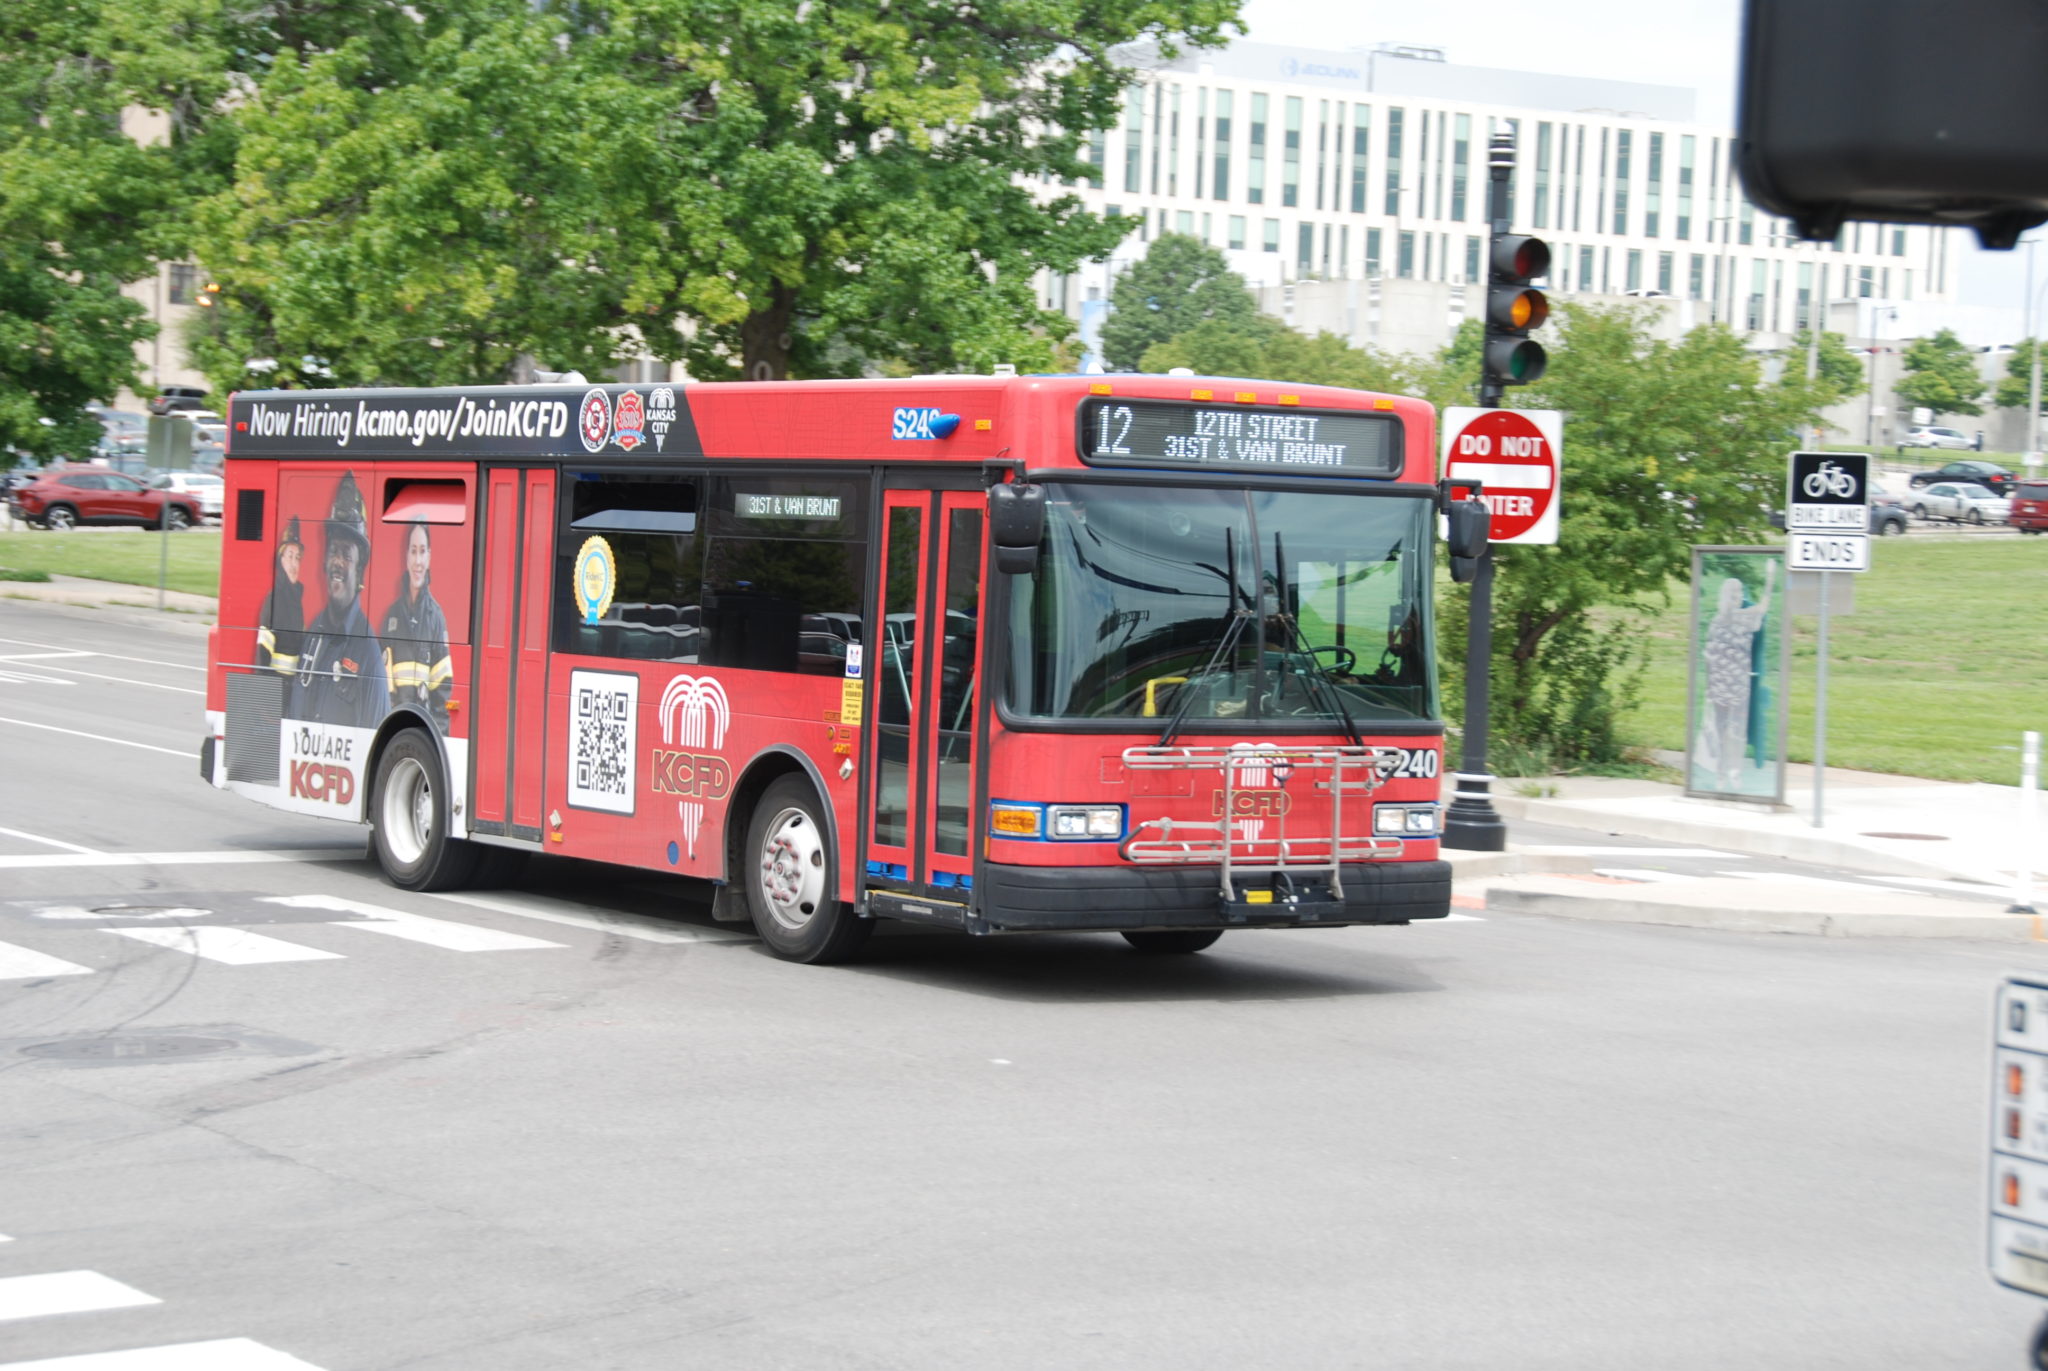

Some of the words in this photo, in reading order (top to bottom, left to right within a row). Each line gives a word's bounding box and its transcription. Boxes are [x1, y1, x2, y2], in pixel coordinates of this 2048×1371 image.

[250, 403, 291, 437] Now
[293, 403, 352, 447] Hiring
[355, 397, 568, 447] kcmo.gov/JoinKCFD
[646, 409, 677, 421] KANSAS
[1194, 411, 1242, 437] 12TH
[1248, 414, 1319, 441] STREET
[651, 422, 670, 434] CITY
[1096, 405, 1134, 454] 12
[1164, 435, 1212, 459] 31ST
[1217, 438, 1229, 460] &
[1235, 439, 1277, 462] VAN
[1282, 442, 1347, 465] BRUNT
[1459, 434, 1492, 456] DO
[1500, 435, 1545, 458] NOT
[749, 496, 772, 514] 31ST
[774, 497, 782, 514] &
[784, 497, 804, 515] VAN
[806, 498, 839, 516] BRUNT
[1794, 507, 1824, 523] BIKE
[1828, 507, 1863, 524] LANE
[1802, 540, 1855, 562] ENDS
[324, 736, 353, 761] ARE
[289, 759, 355, 805] KCFD
[652, 749, 731, 800] KCFD
